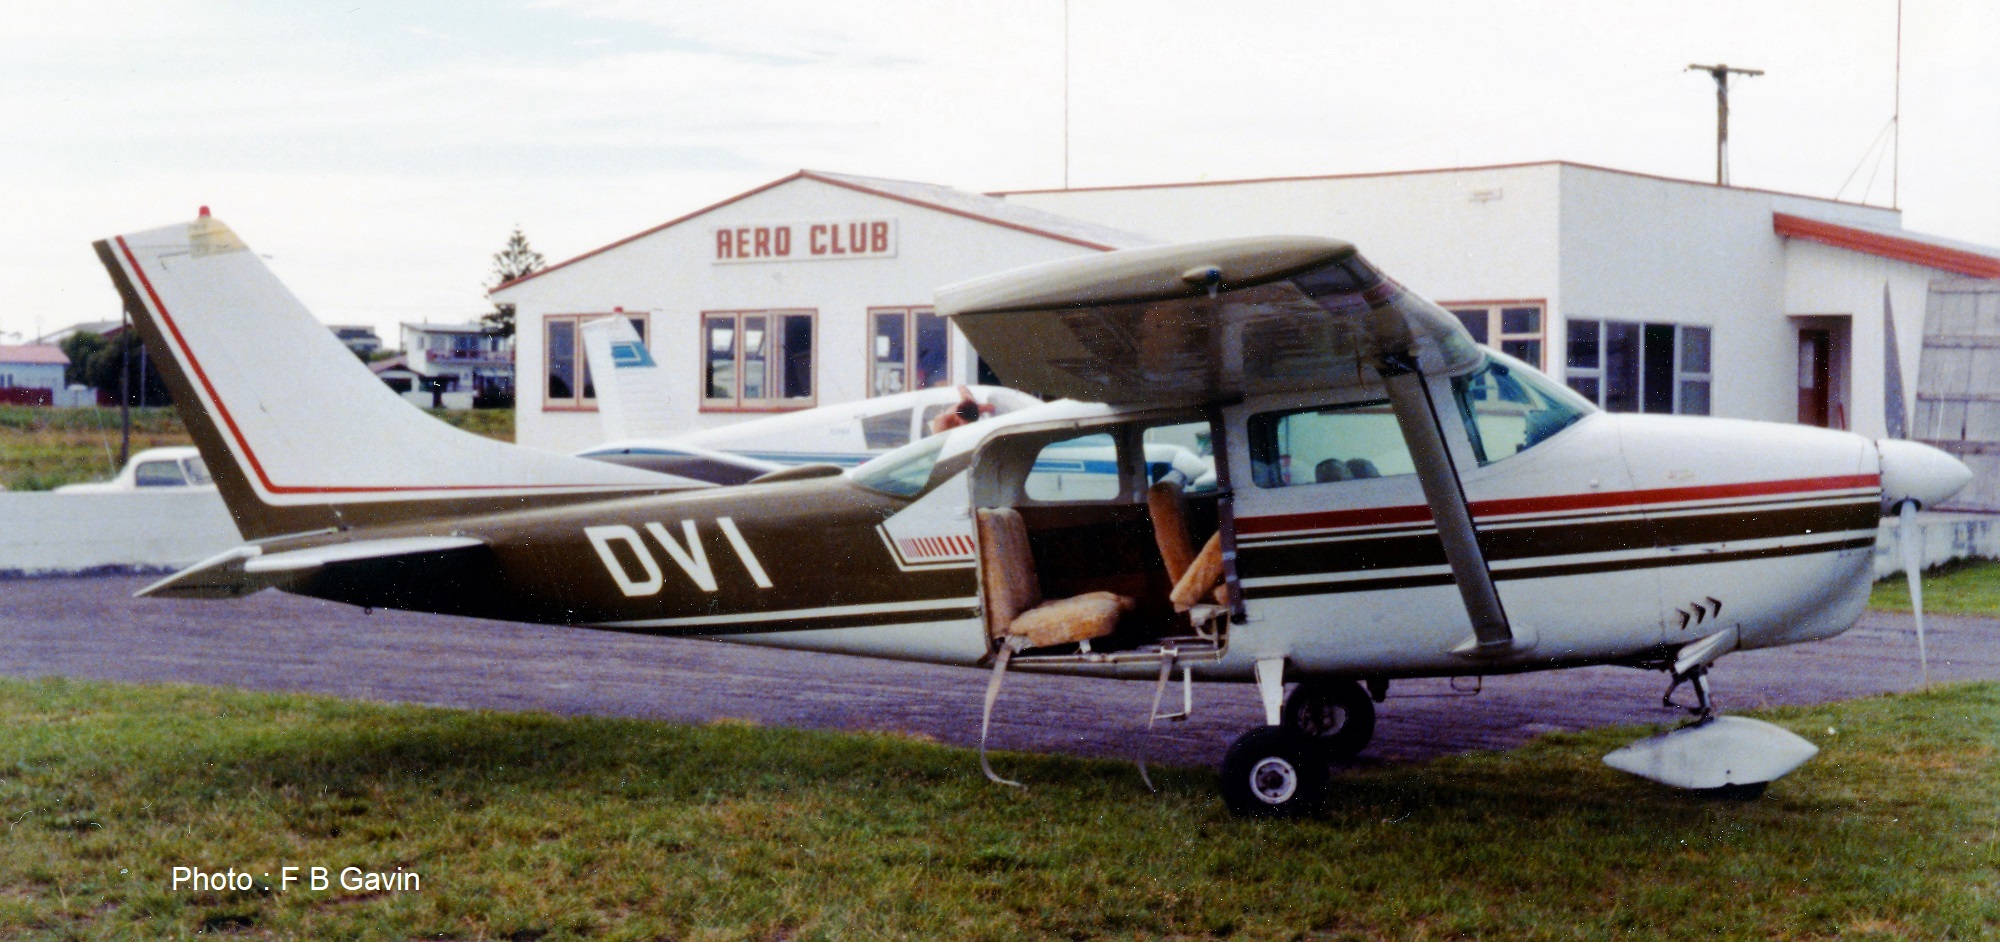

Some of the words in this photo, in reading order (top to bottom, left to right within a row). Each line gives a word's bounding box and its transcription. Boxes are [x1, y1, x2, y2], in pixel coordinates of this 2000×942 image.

[716, 226, 791, 259] AERO
[810, 221, 889, 255] CLUB
[584, 516, 774, 597] DVI
